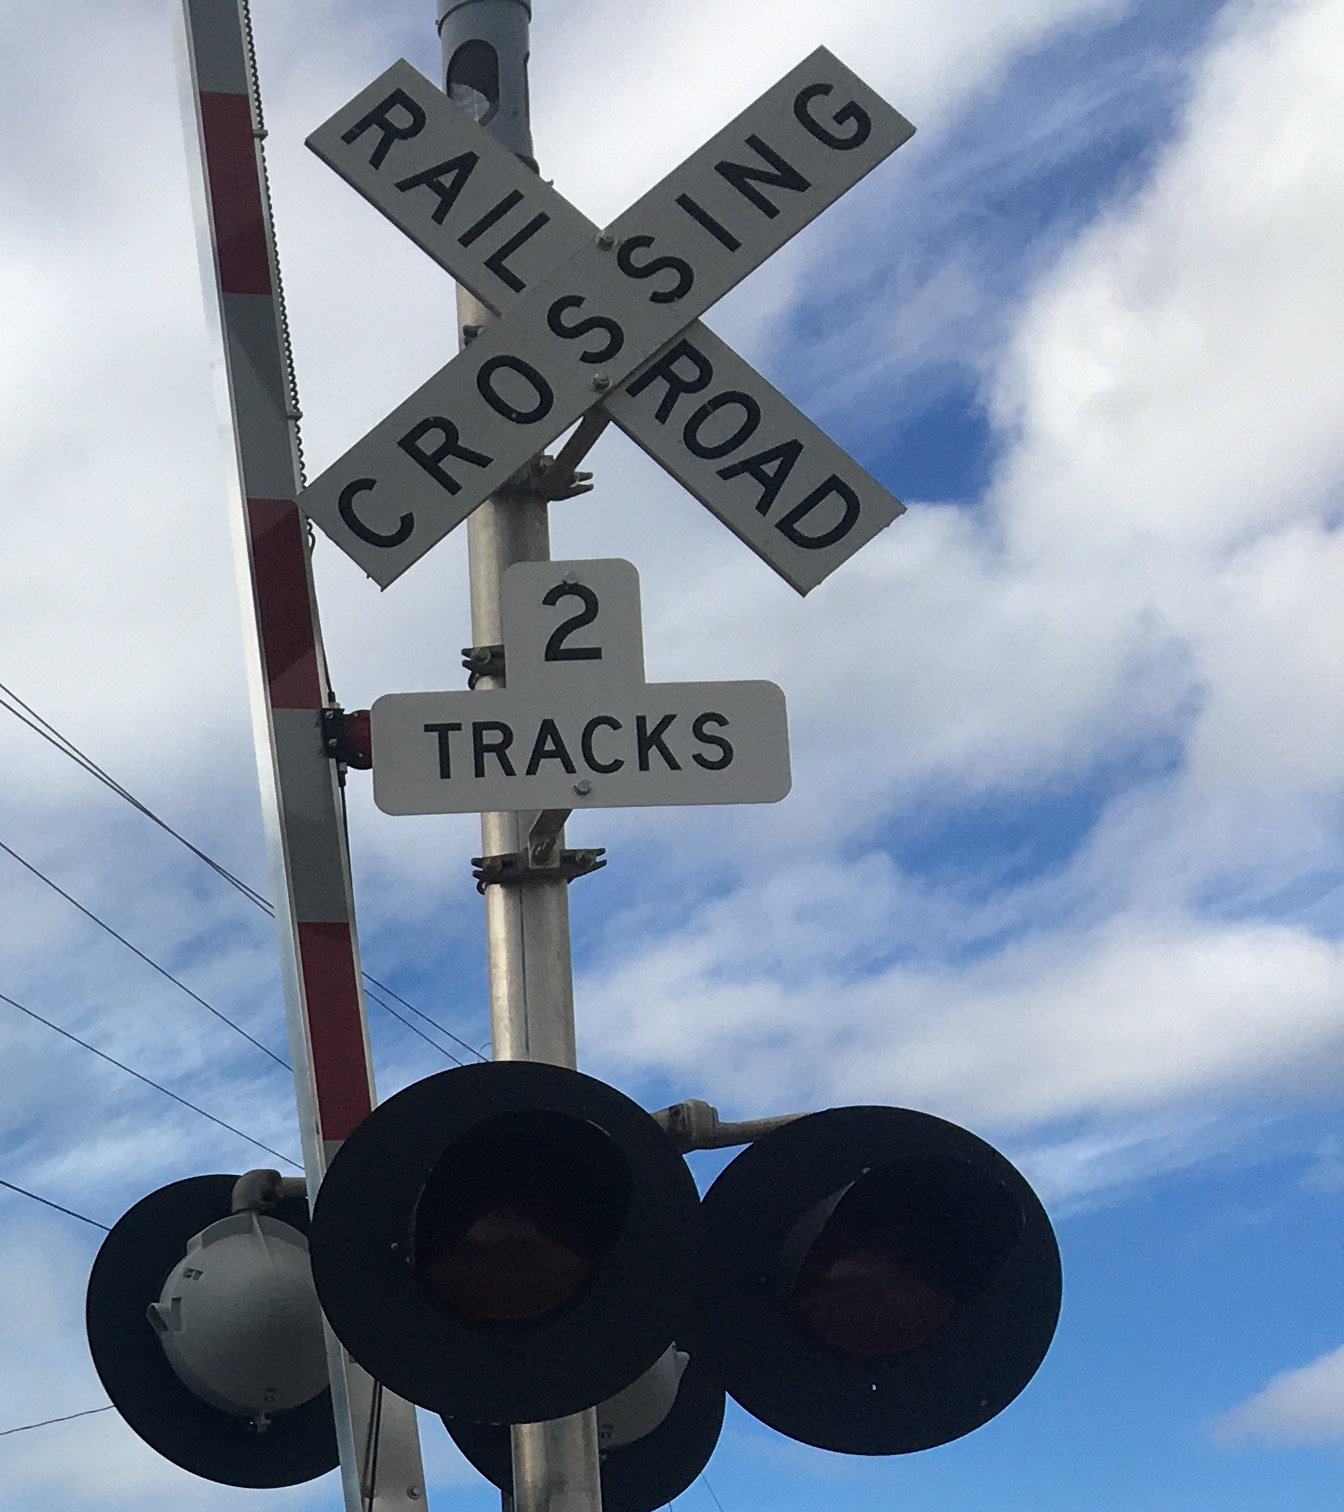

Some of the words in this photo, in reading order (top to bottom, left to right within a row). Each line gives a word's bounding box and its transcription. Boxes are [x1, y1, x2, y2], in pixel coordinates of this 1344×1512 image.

[336, 80, 874, 552] CROSSING
[339, 85, 552, 294] RAIL
[626, 337, 863, 552] ROAD
[423, 711, 735, 780] TRACKS
[541, 582, 604, 663] 2
